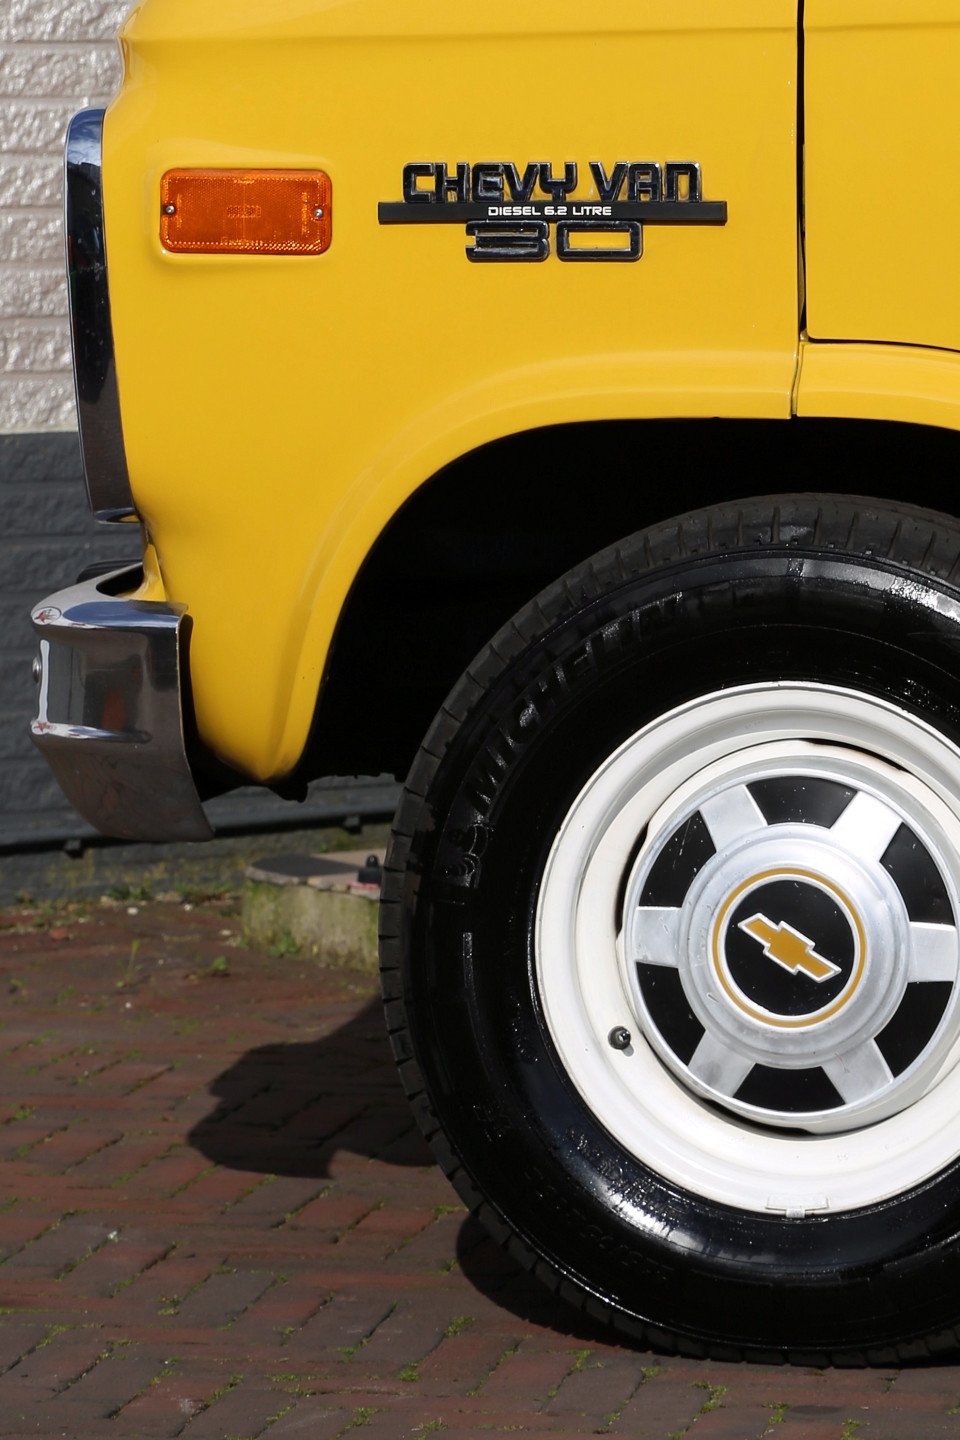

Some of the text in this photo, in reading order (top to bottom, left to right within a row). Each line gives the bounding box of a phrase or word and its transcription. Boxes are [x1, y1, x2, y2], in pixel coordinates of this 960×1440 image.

[402, 160, 701, 203] CHEVY VAN
[488, 206, 612, 216] DIESEL 6.2 LITRE
[465, 220, 643, 262] 30
